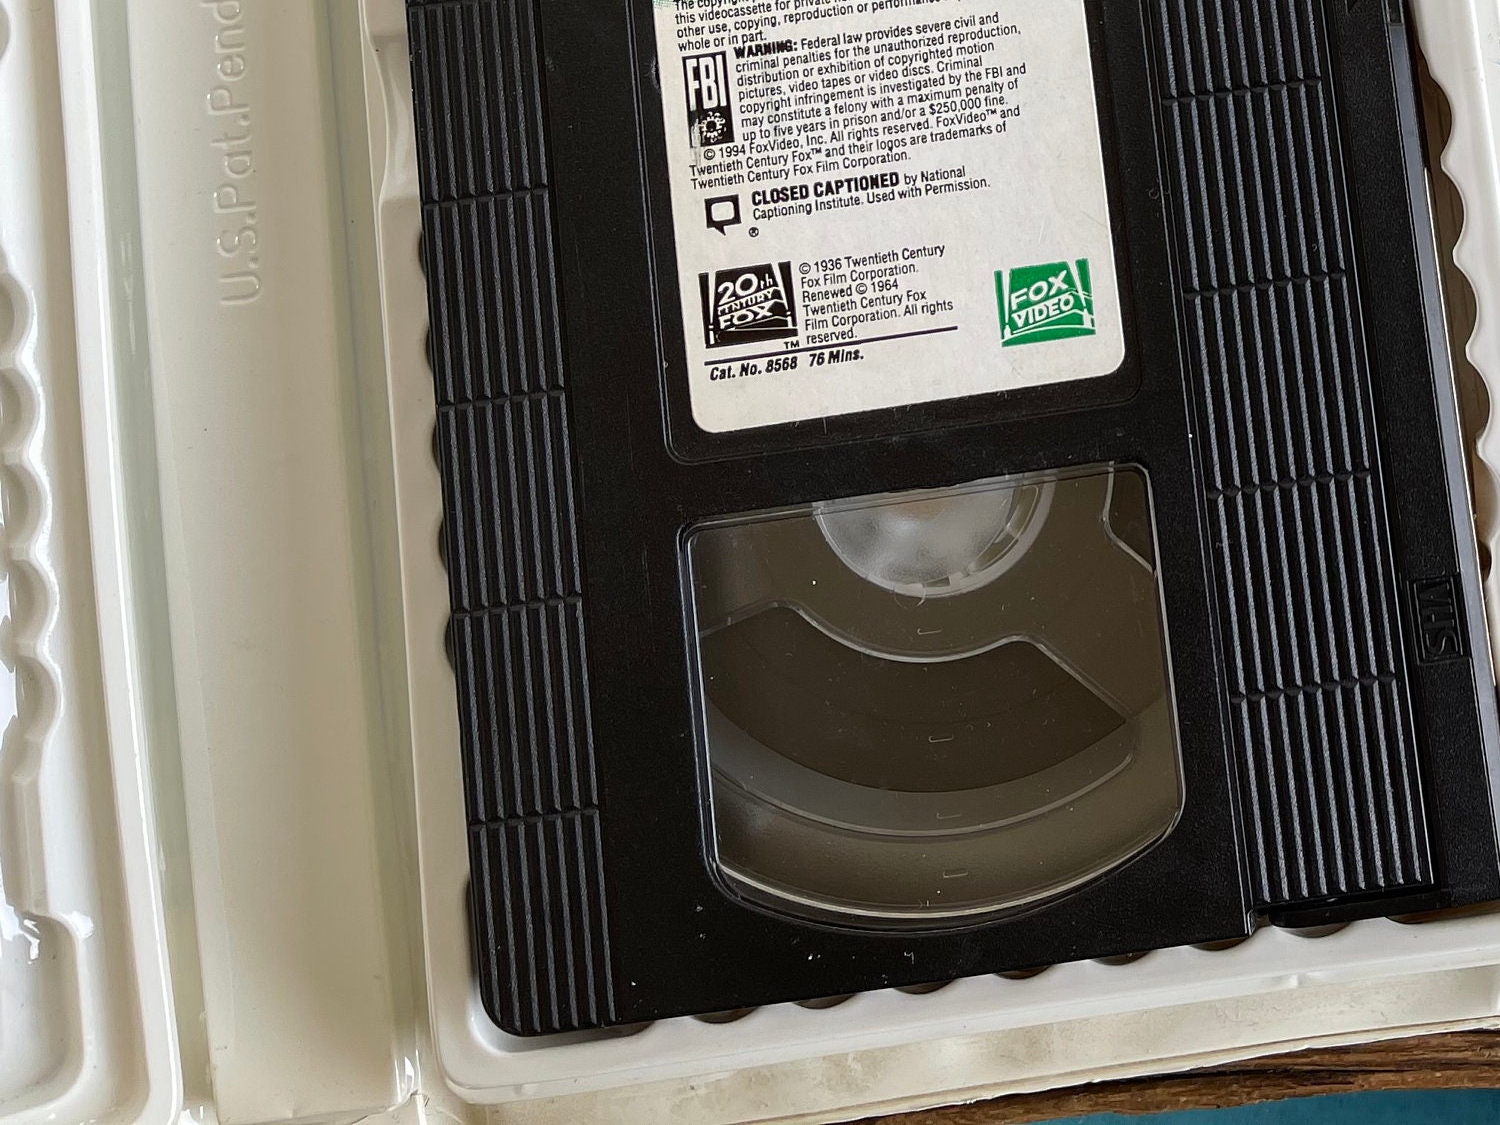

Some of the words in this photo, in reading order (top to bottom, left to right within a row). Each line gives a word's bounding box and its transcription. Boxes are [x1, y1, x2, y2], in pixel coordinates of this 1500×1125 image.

[685, 54, 726, 111] FBI
[719, 143, 745, 158] 1994
[749, 138, 803, 154] FoxVideo,
[806, 134, 827, 146] Inc.
[830, 130, 844, 143] All
[847, 126, 879, 141] rights
[882, 118, 931, 135] reserved.
[1000, 104, 1020, 118] and
[688, 159, 742, 176] Twentieth
[746, 154, 788, 169] Century
[825, 144, 845, 157] and
[848, 140, 873, 154] their
[876, 137, 907, 151] logos
[909, 134, 927, 145] are
[930, 124, 992, 142] trademarks
[995, 120, 1006, 133] of
[690, 172, 744, 189] Twentieth
[747, 168, 789, 182] Century
[793, 164, 813, 176] Fox
[815, 160, 839, 172] Film
[842, 151, 910, 169] Corporation.
[751, 184, 809, 206] CLOSED
[813, 171, 899, 197] CAPTIONED
[903, 173, 917, 186] by
[920, 165, 965, 182] National
[753, 203, 812, 220] Captioning
[815, 195, 863, 211] Institute.
[866, 188, 895, 203] Used
[897, 186, 921, 198] with
[924, 178, 990, 195] Permission.
[814, 257, 842, 272] 1936
[843, 249, 898, 268] Twentieth
[901, 245, 945, 260] Century
[800, 276, 820, 288] Fox
[823, 272, 846, 285] Film
[850, 263, 917, 282] Corporation.
[802, 284, 852, 303] Renewed
[871, 278, 898, 292] 1964
[1010, 269, 1069, 311] FOX
[718, 300, 775, 329] FOX
[802, 298, 857, 316] Twentieth
[860, 294, 903, 308] Century
[906, 289, 926, 301] Fox
[804, 318, 828, 331] Film
[831, 308, 899, 327] Corporation.
[903, 303, 917, 316] All
[921, 300, 953, 315] rights
[1010, 294, 1074, 328] VIDEO
[806, 326, 857, 344] reserved.
[710, 365, 735, 380] Cat.
[739, 362, 762, 376] No.
[765, 356, 797, 373] 8568
[809, 351, 824, 367] 76
[827, 349, 863, 364] Mins.
